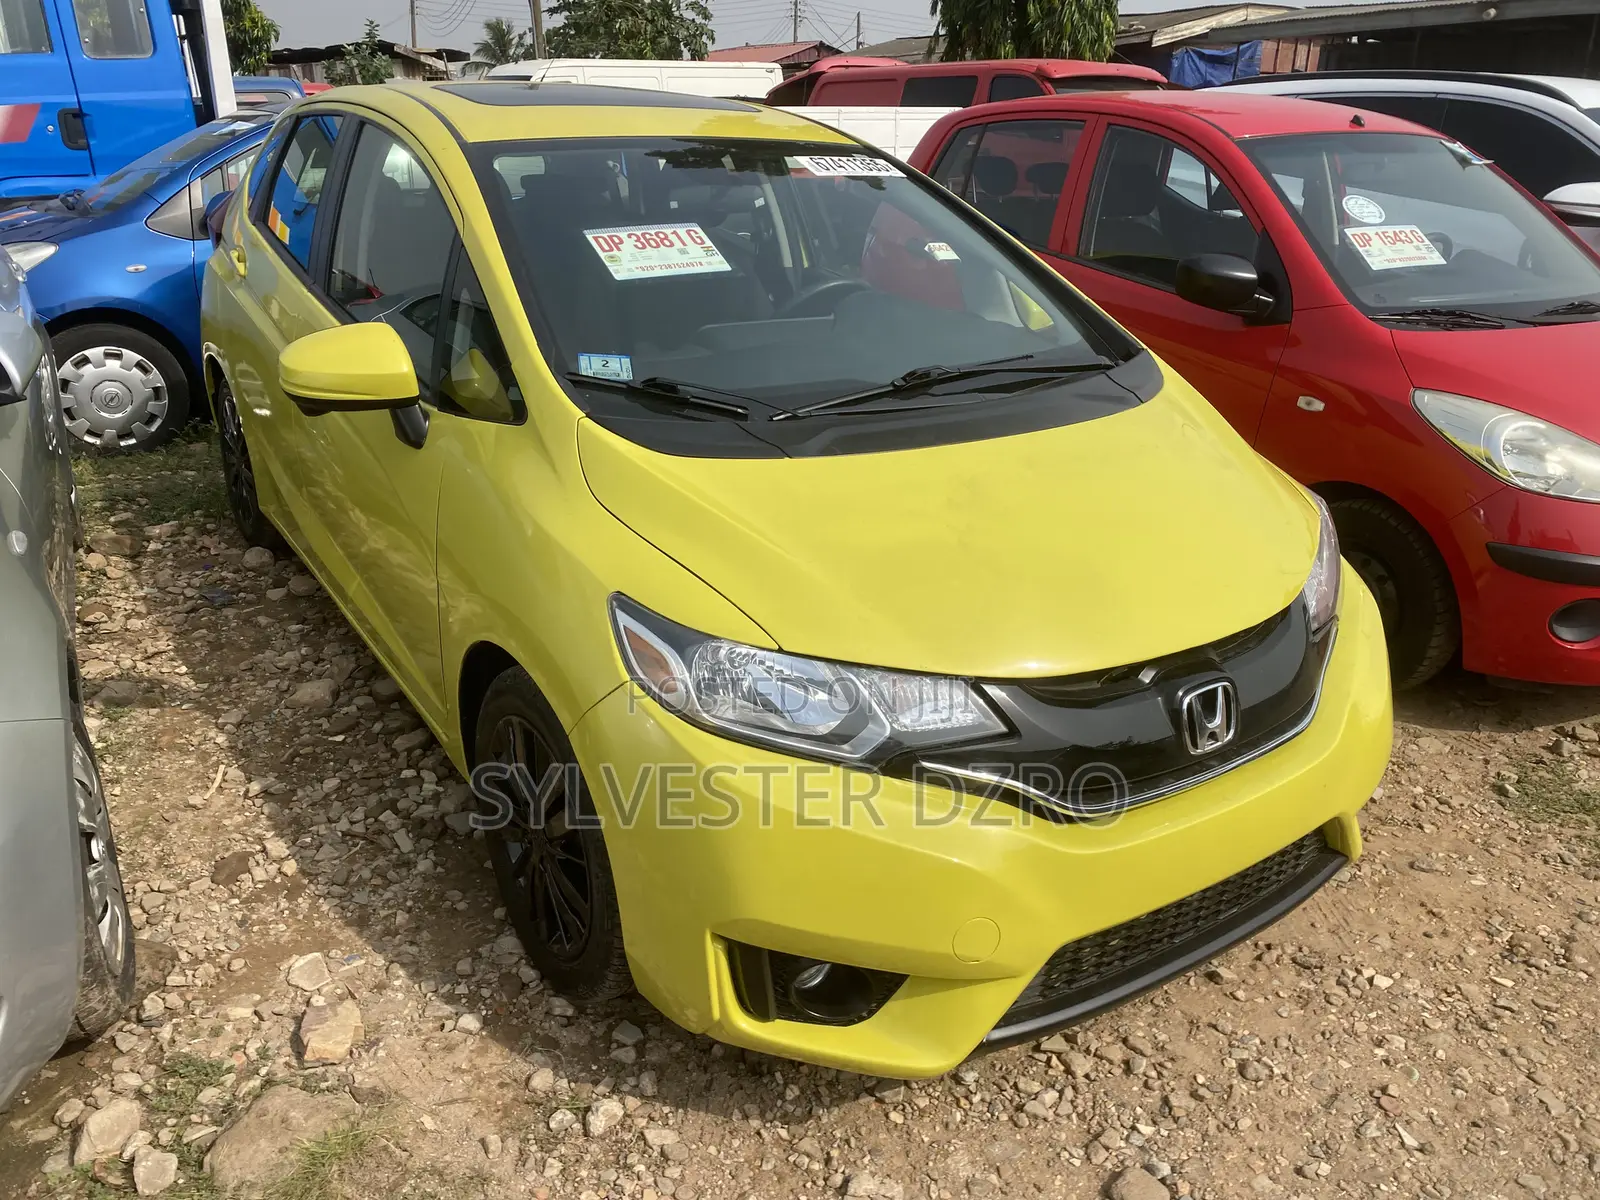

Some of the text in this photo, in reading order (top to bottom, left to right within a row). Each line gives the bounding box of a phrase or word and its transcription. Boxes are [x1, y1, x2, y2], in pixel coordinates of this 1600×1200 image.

[592, 228, 706, 253] DP 3681 G
[1350, 229, 1426, 248] DP 1543 G
[601, 359, 610, 368] 2
